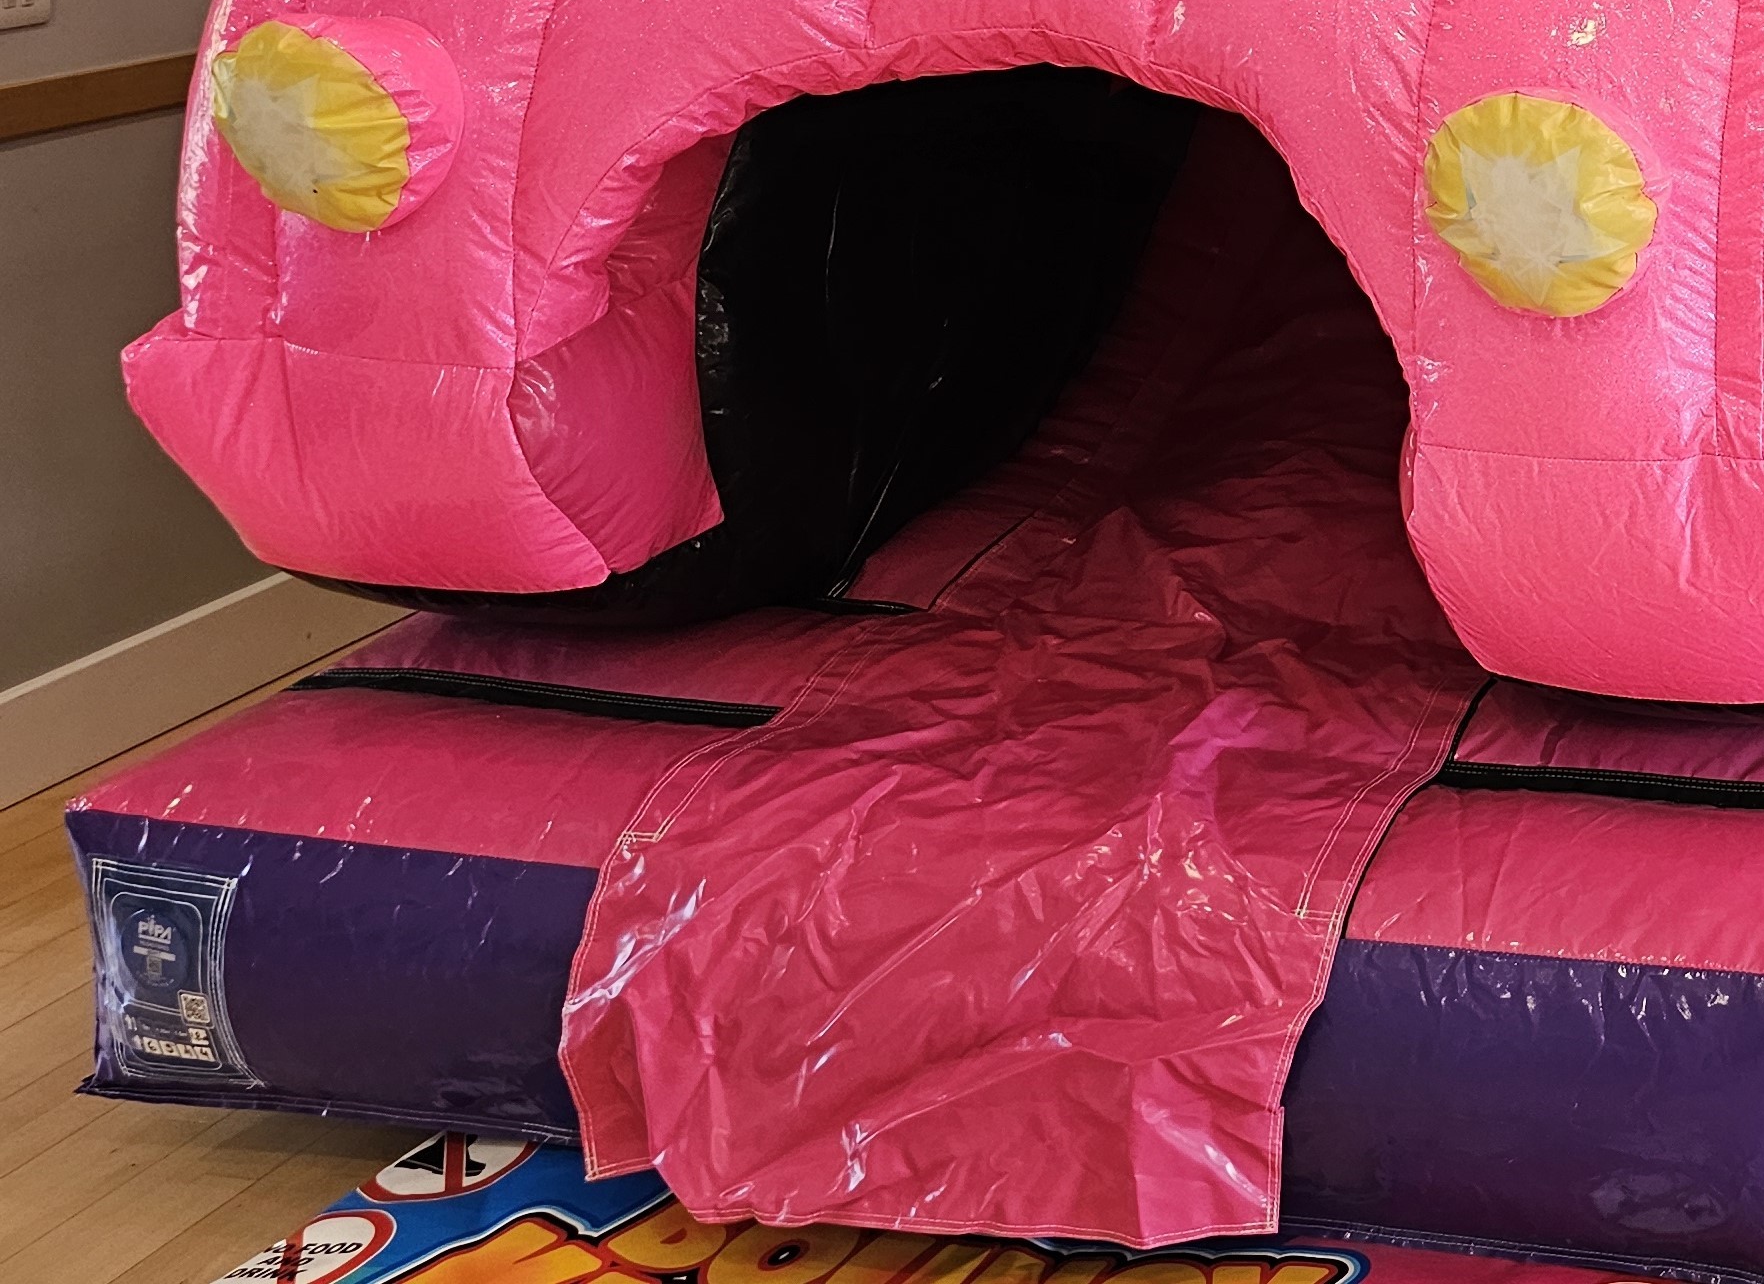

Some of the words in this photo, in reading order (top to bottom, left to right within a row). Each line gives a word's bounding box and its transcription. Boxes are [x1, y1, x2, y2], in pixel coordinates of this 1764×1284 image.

[295, 1242, 363, 1255] FOOD
[256, 1256, 315, 1267] AND
[224, 1268, 308, 1281] DRINK
